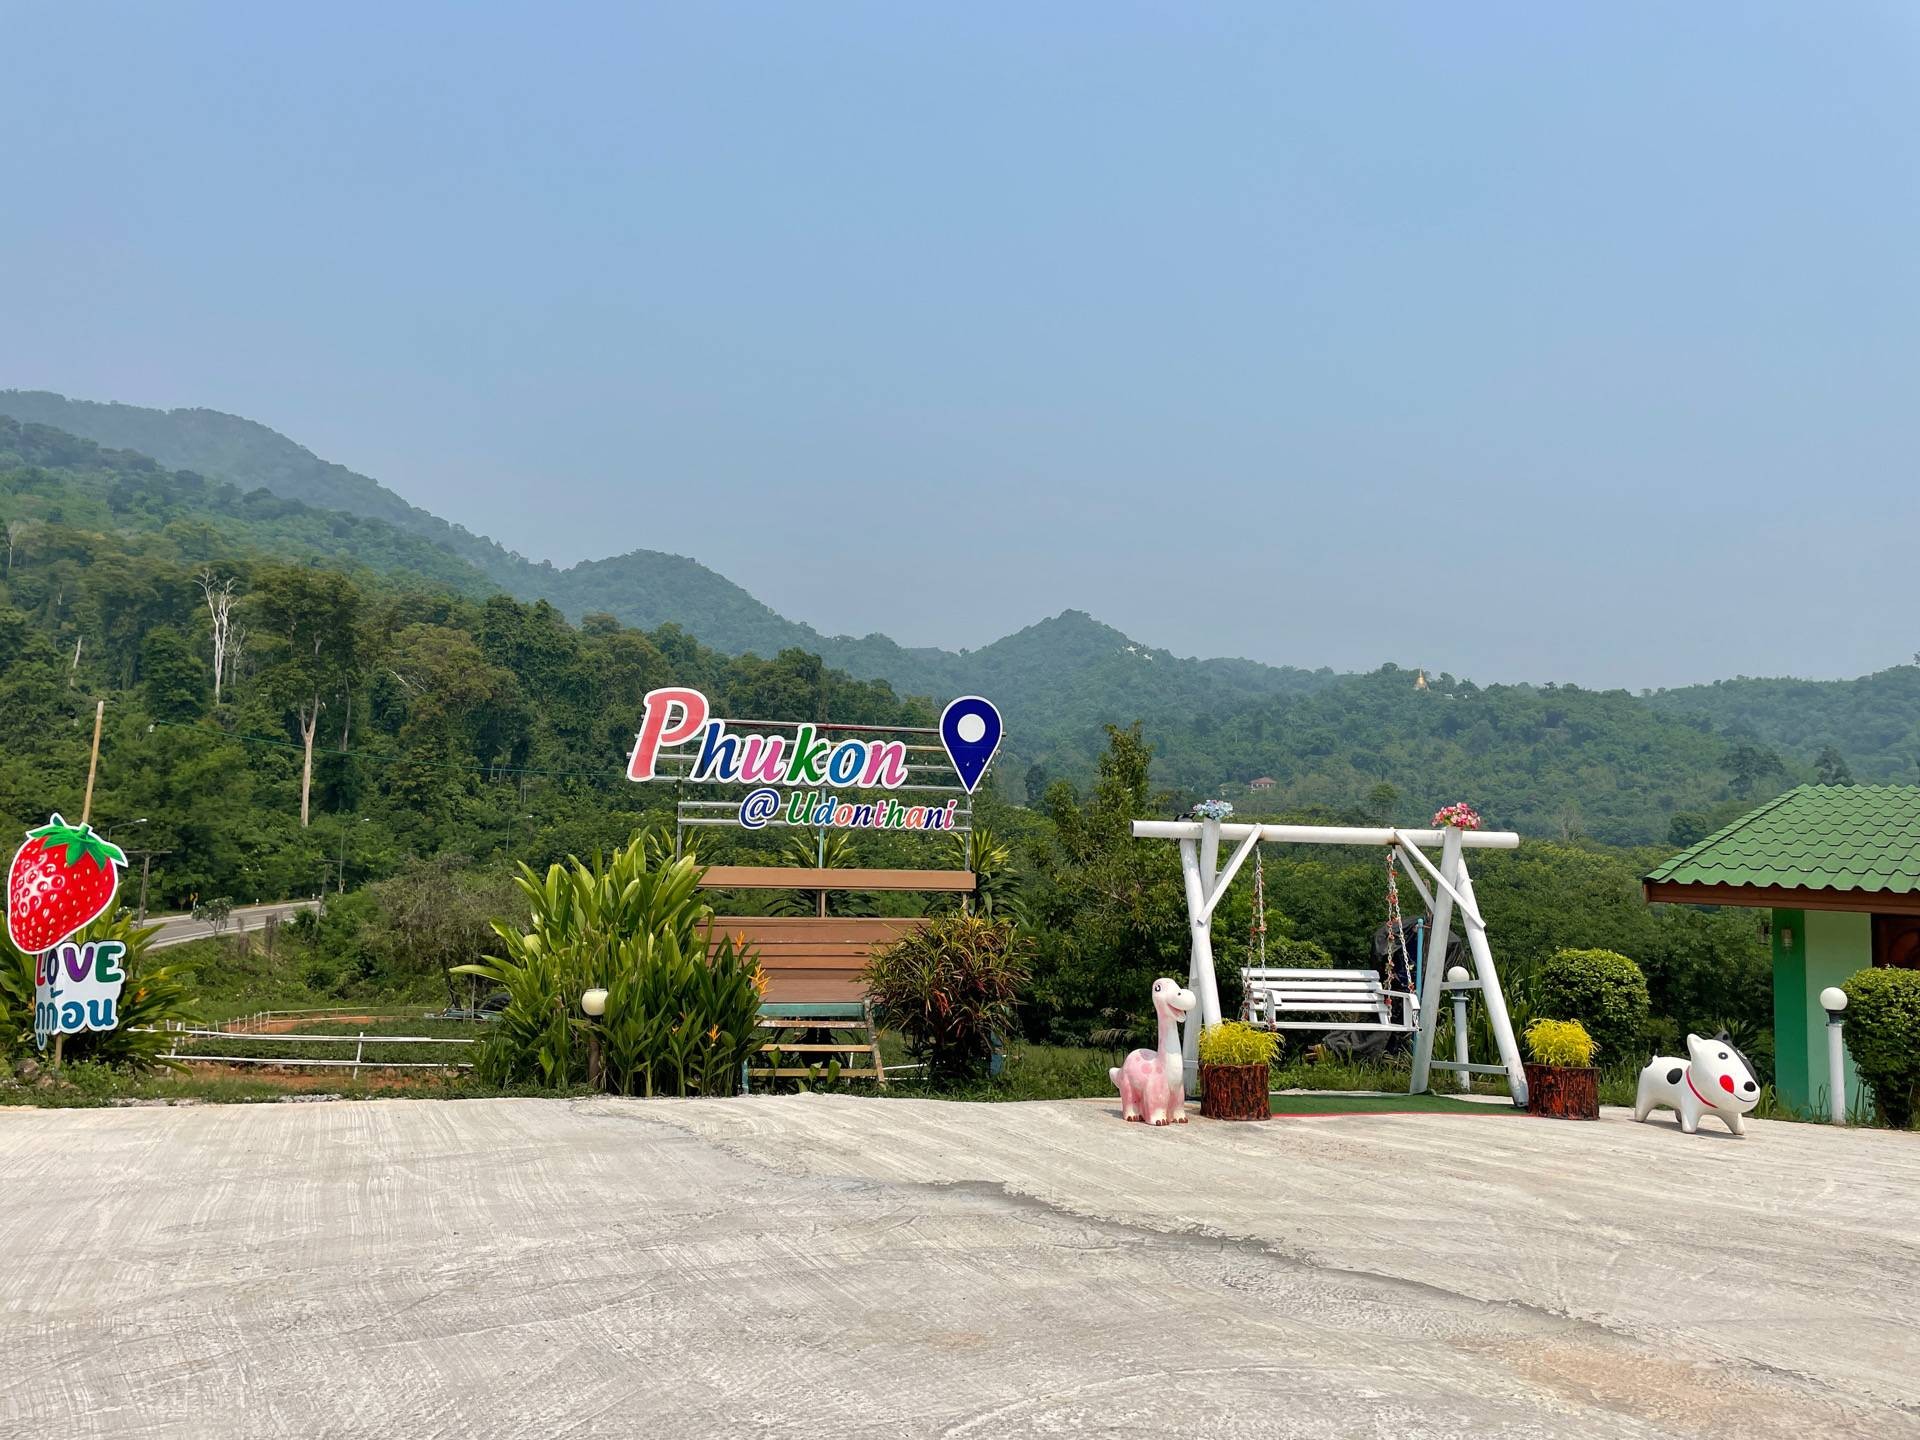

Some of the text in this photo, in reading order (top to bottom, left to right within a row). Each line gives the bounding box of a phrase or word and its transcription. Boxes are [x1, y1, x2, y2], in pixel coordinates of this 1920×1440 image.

[628, 688, 907, 788] Phukon
[741, 790, 956, 829] @ Udonthani
[36, 946, 122, 986] LOVE
